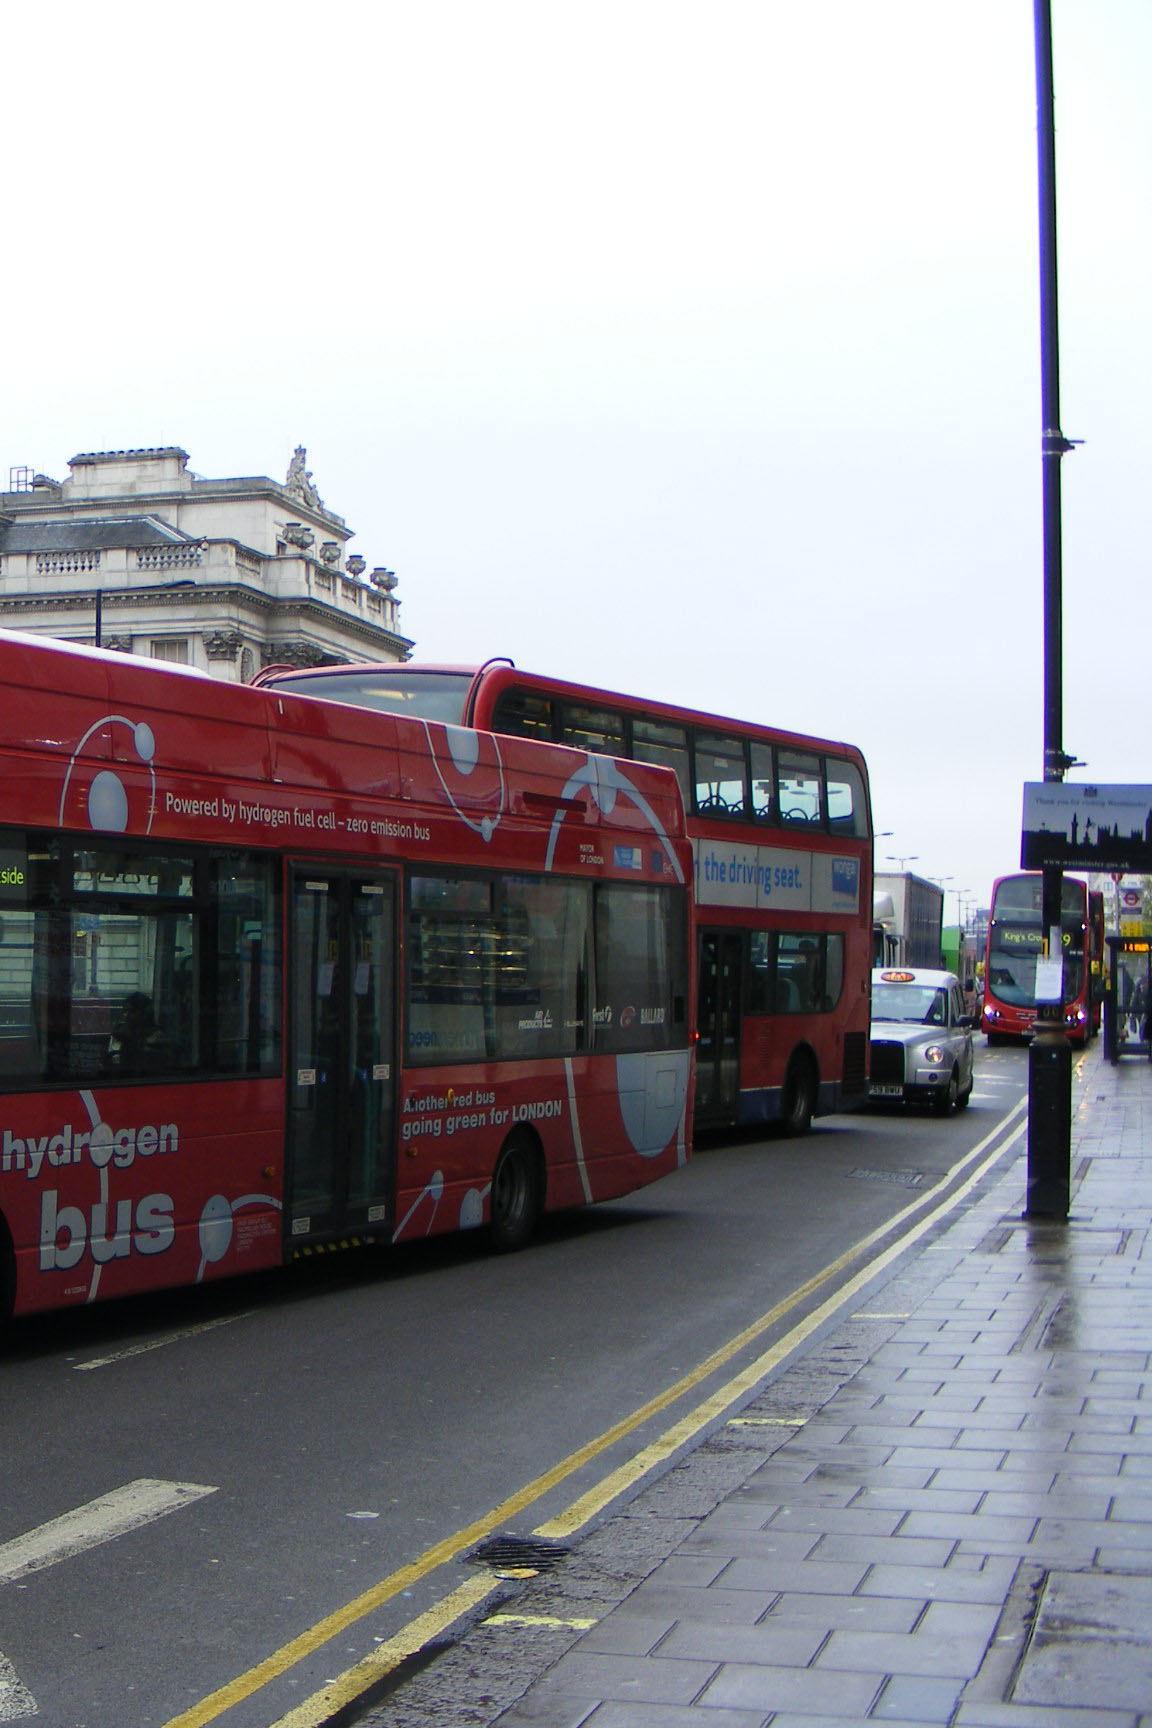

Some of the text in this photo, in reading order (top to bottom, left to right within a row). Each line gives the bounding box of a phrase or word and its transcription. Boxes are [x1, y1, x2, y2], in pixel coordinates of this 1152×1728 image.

[166, 792, 219, 817] Powered
[222, 797, 236, 823] by
[239, 803, 290, 828] hydrogen
[294, 807, 315, 828] fuel
[317, 812, 336, 830] cell
[346, 818, 368, 834] zero
[370, 820, 412, 839] emission
[414, 822, 430, 841] bus
[704, 852, 726, 882] the
[729, 855, 772, 896] driving
[774, 864, 802, 889] seat.
[1004, 931, 1025, 943] King's
[402, 1100, 562, 1140] going green for LONDON
[453, 1091, 472, 1108] red
[476, 1090, 496, 1104] bus
[2, 1122, 179, 1180] hydrogen
[39, 1189, 176, 1272] bus
